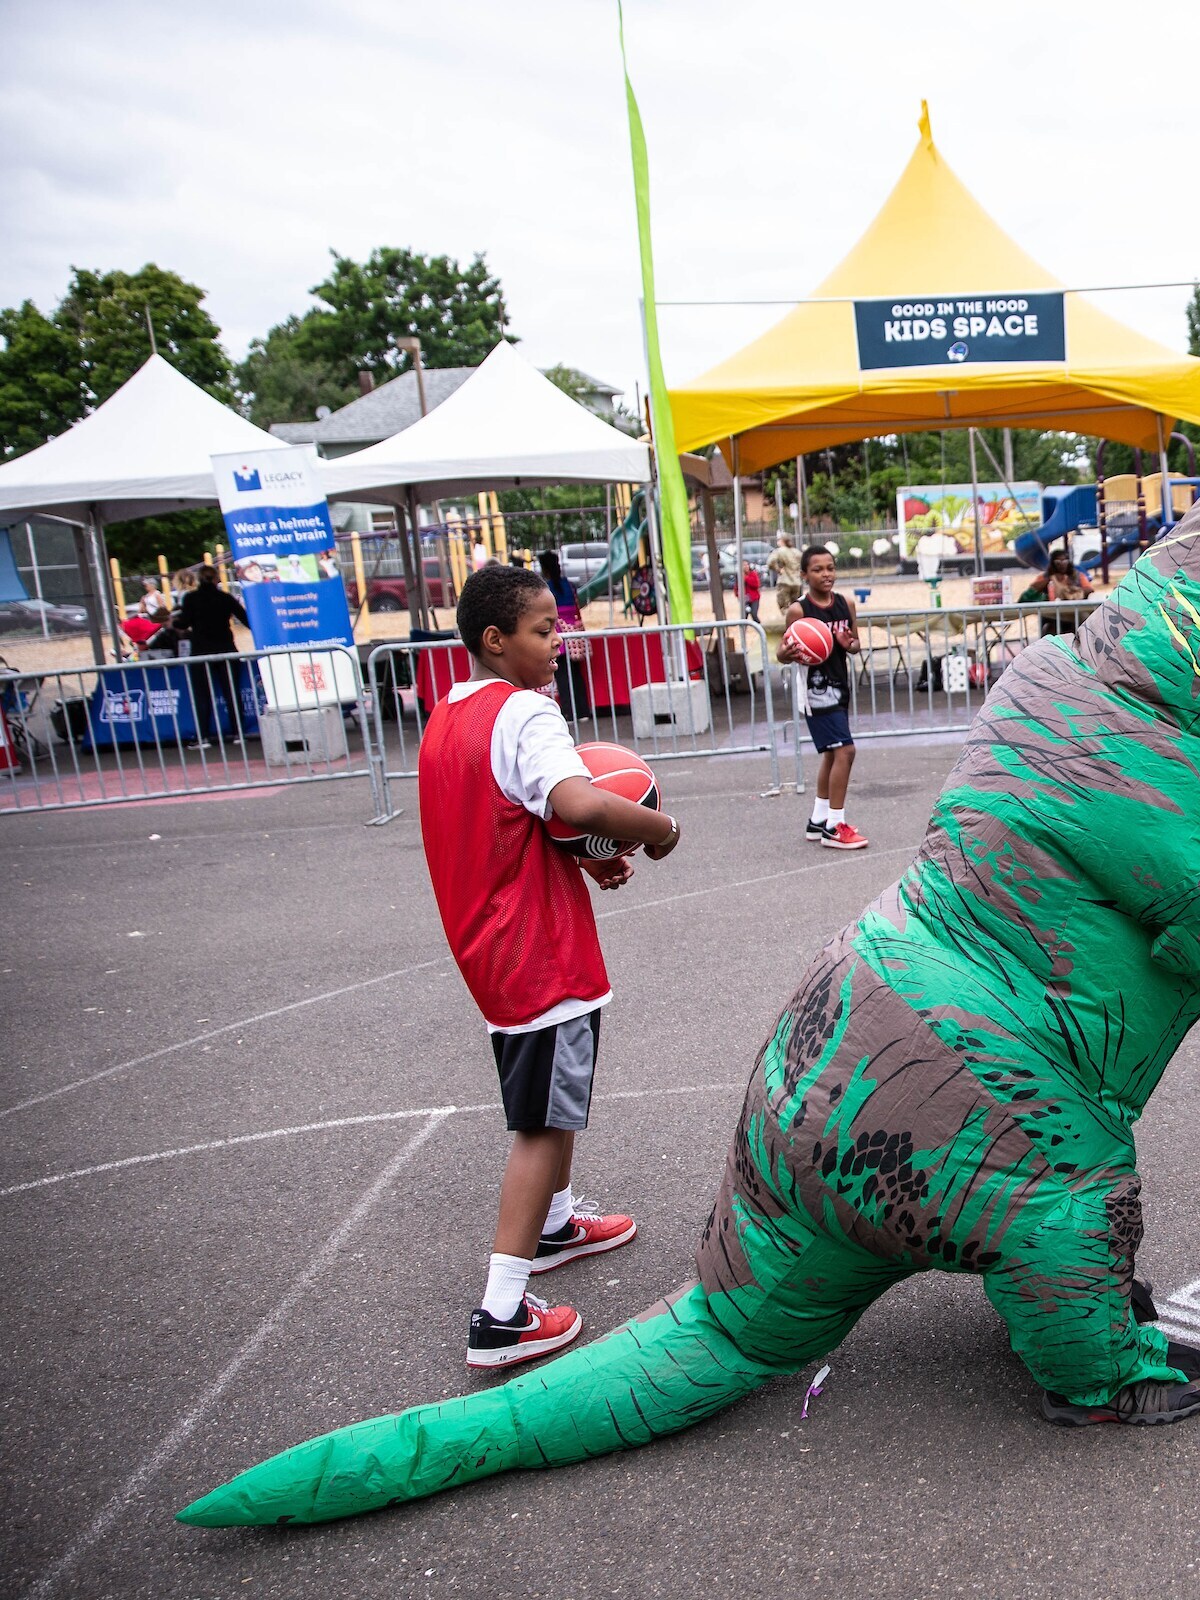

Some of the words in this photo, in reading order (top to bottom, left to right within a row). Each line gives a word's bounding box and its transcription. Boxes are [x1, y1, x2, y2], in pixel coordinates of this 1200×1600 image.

[891, 303, 935, 317] GOOD
[937, 302, 954, 315] IN
[956, 301, 983, 314] THE
[986, 299, 1028, 313] HOOD
[884, 318, 947, 342] KIDS
[953, 315, 1039, 338] SPACE
[264, 472, 304, 482] LEGACY
[233, 522, 267, 534] Wear
[269, 522, 277, 531] a
[236, 536, 264, 547] save
[265, 534, 293, 548] your
[293, 528, 327, 542] brain
[271, 596, 286, 604] Use
[287, 592, 318, 602] correctly
[276, 608, 287, 616] Fit
[288, 606, 318, 616] properly
[282, 621, 300, 630] Start
[301, 619, 319, 629] early
